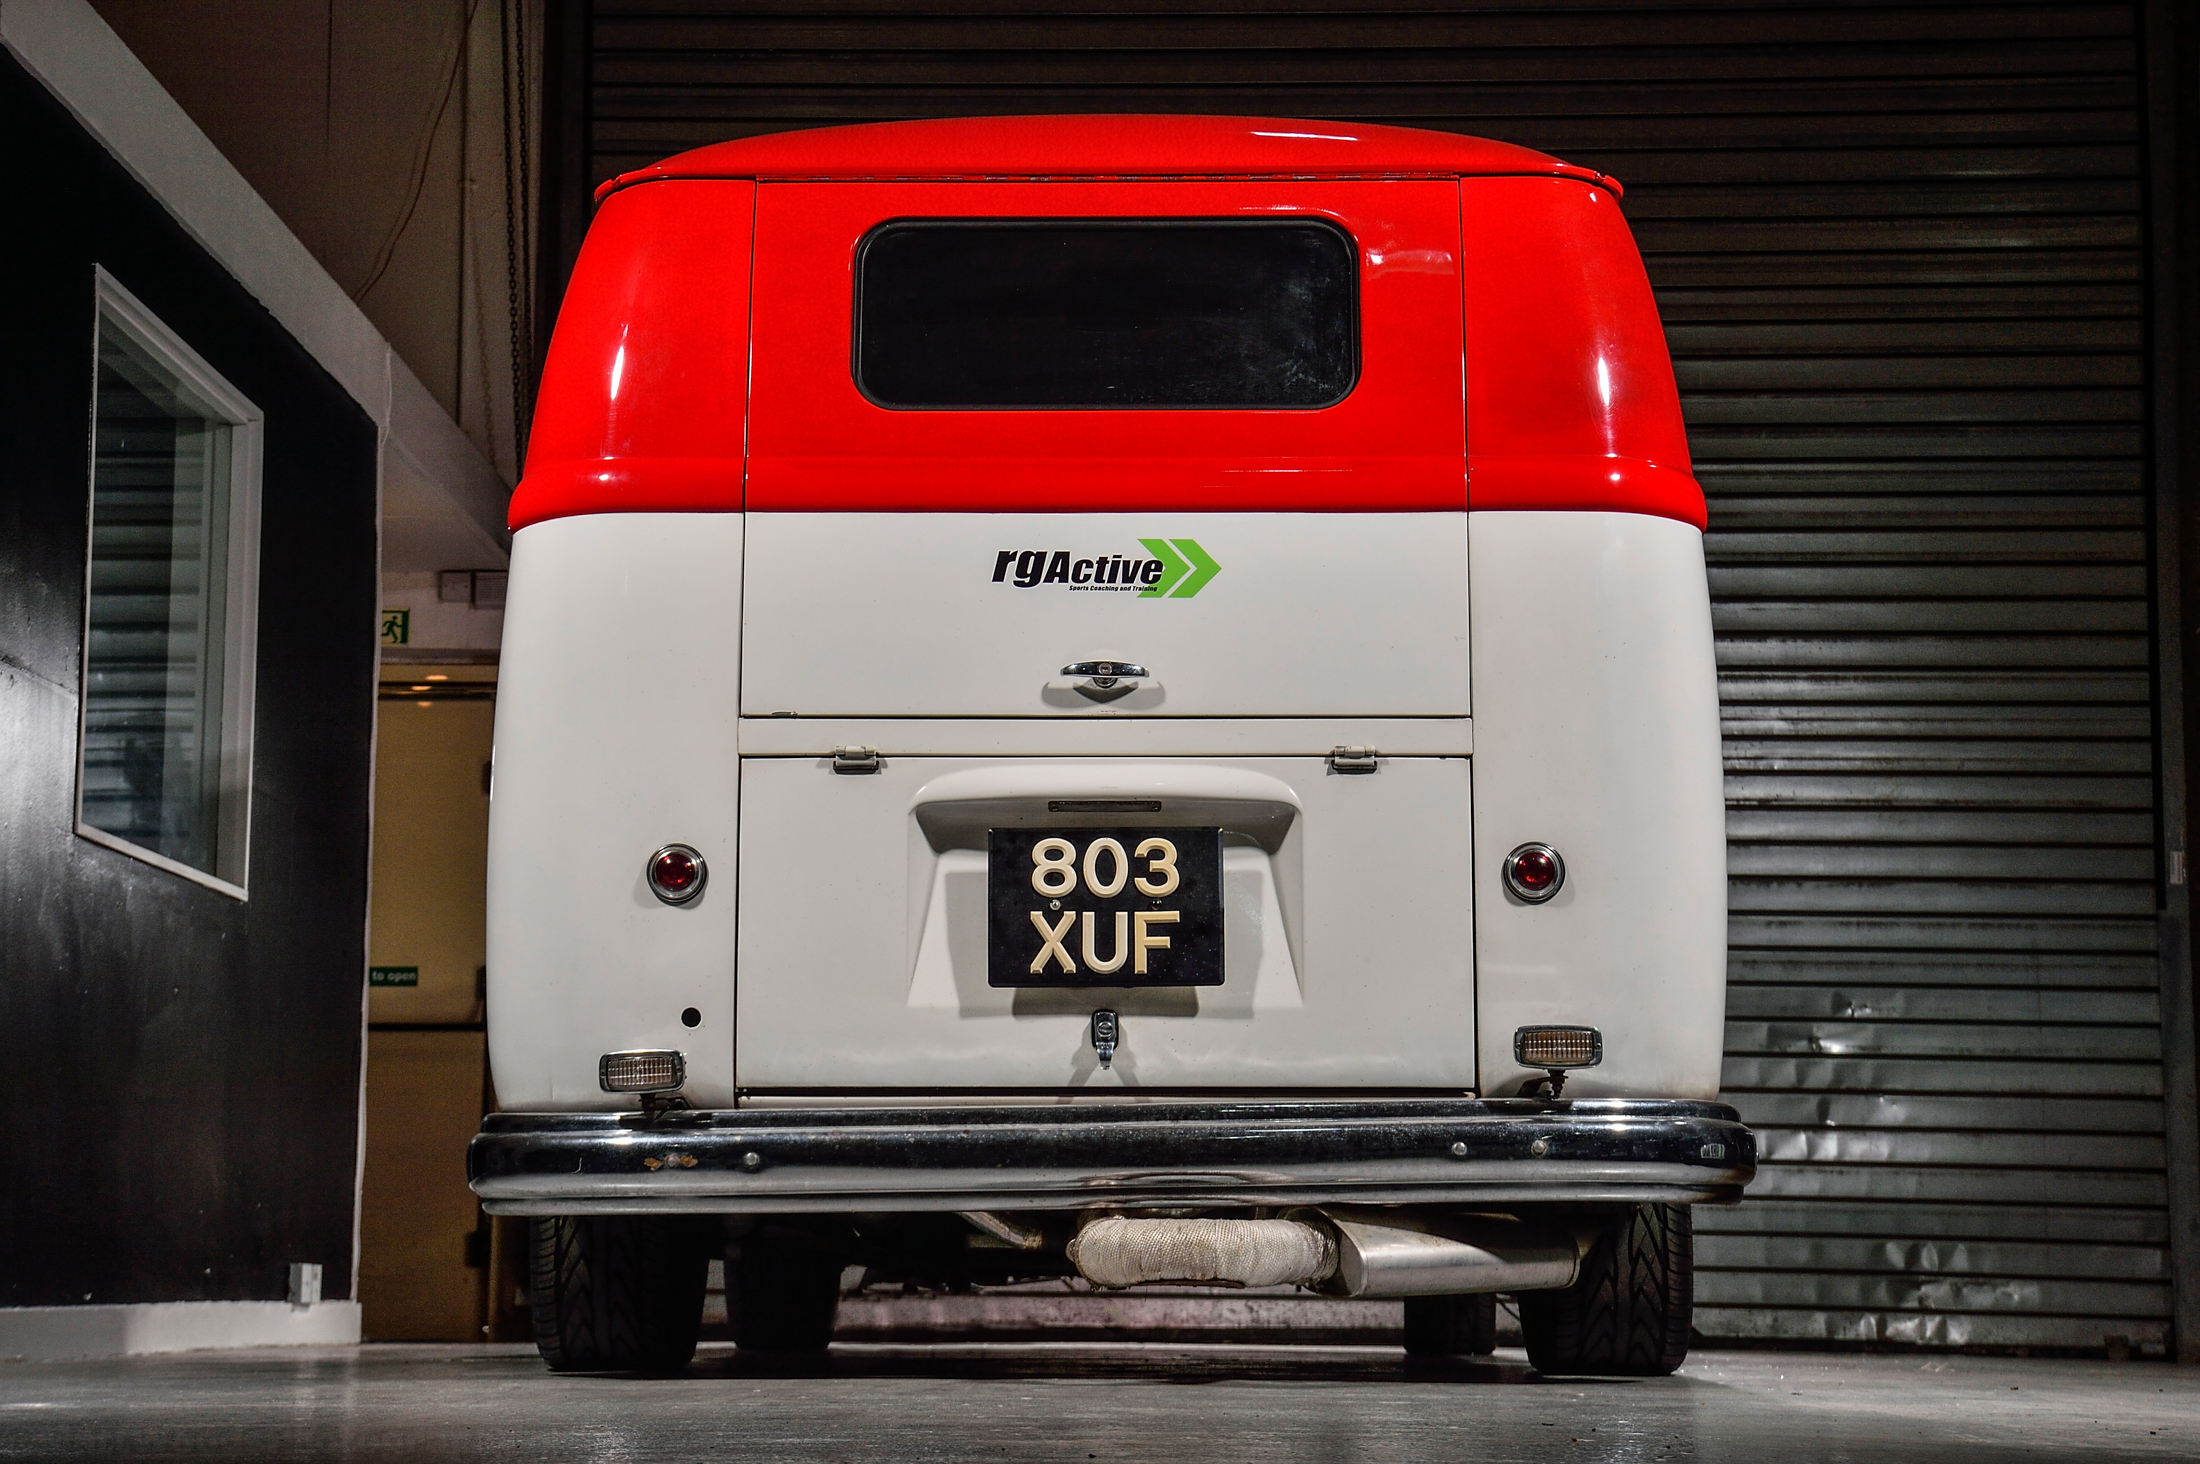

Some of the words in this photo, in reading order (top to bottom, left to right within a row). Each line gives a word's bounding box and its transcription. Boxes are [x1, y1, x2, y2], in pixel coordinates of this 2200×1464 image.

[992, 550, 1163, 588] rgActive
[1031, 837, 1180, 898] 803
[1030, 911, 1180, 974] XUF
[372, 971, 384, 980] to
[387, 972, 416, 983] open
